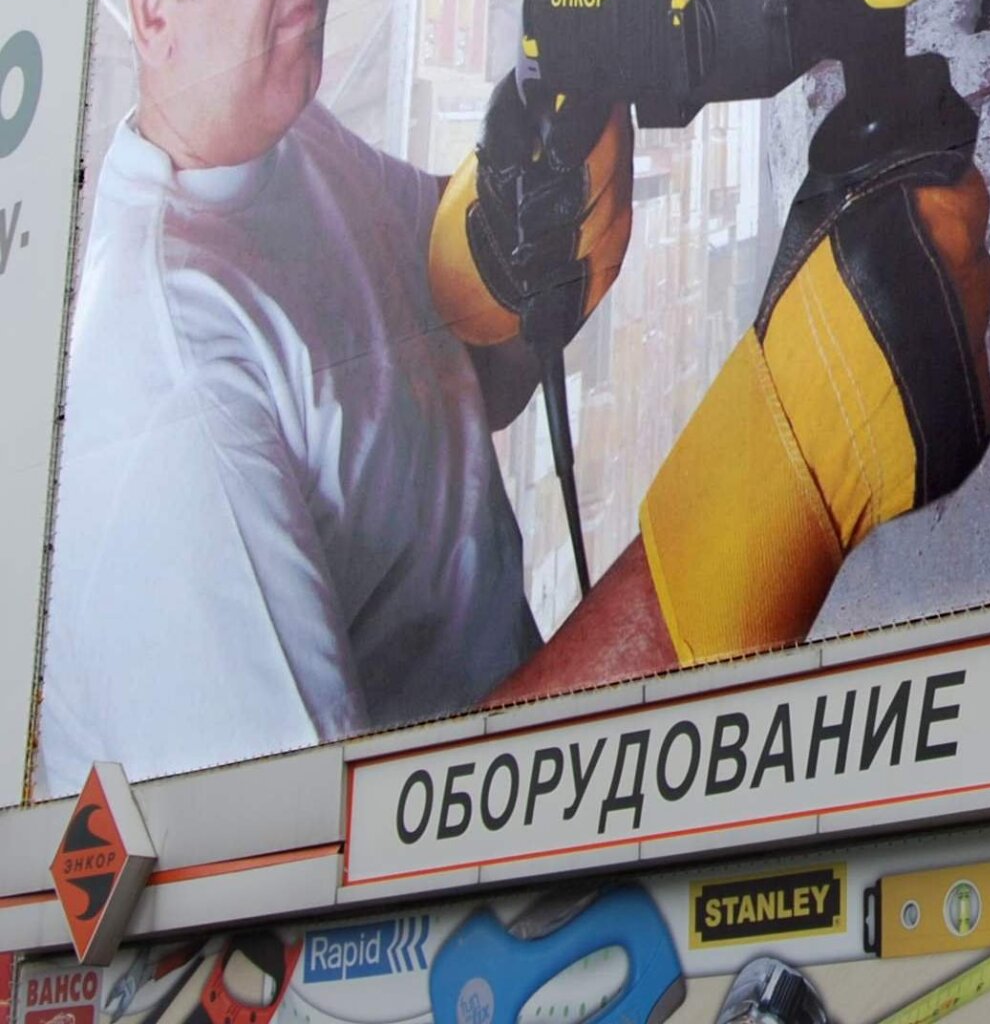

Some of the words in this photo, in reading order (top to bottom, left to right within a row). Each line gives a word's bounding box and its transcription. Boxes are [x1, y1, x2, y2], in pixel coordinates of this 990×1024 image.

[397, 670, 965, 845] ОБОРУДОВАНИЕ
[63, 851, 116, 874] ЭНКОР
[705, 884, 830, 927] STANLEY
[310, 930, 381, 980] Rapid
[27, 970, 98, 1007] BAHCO
